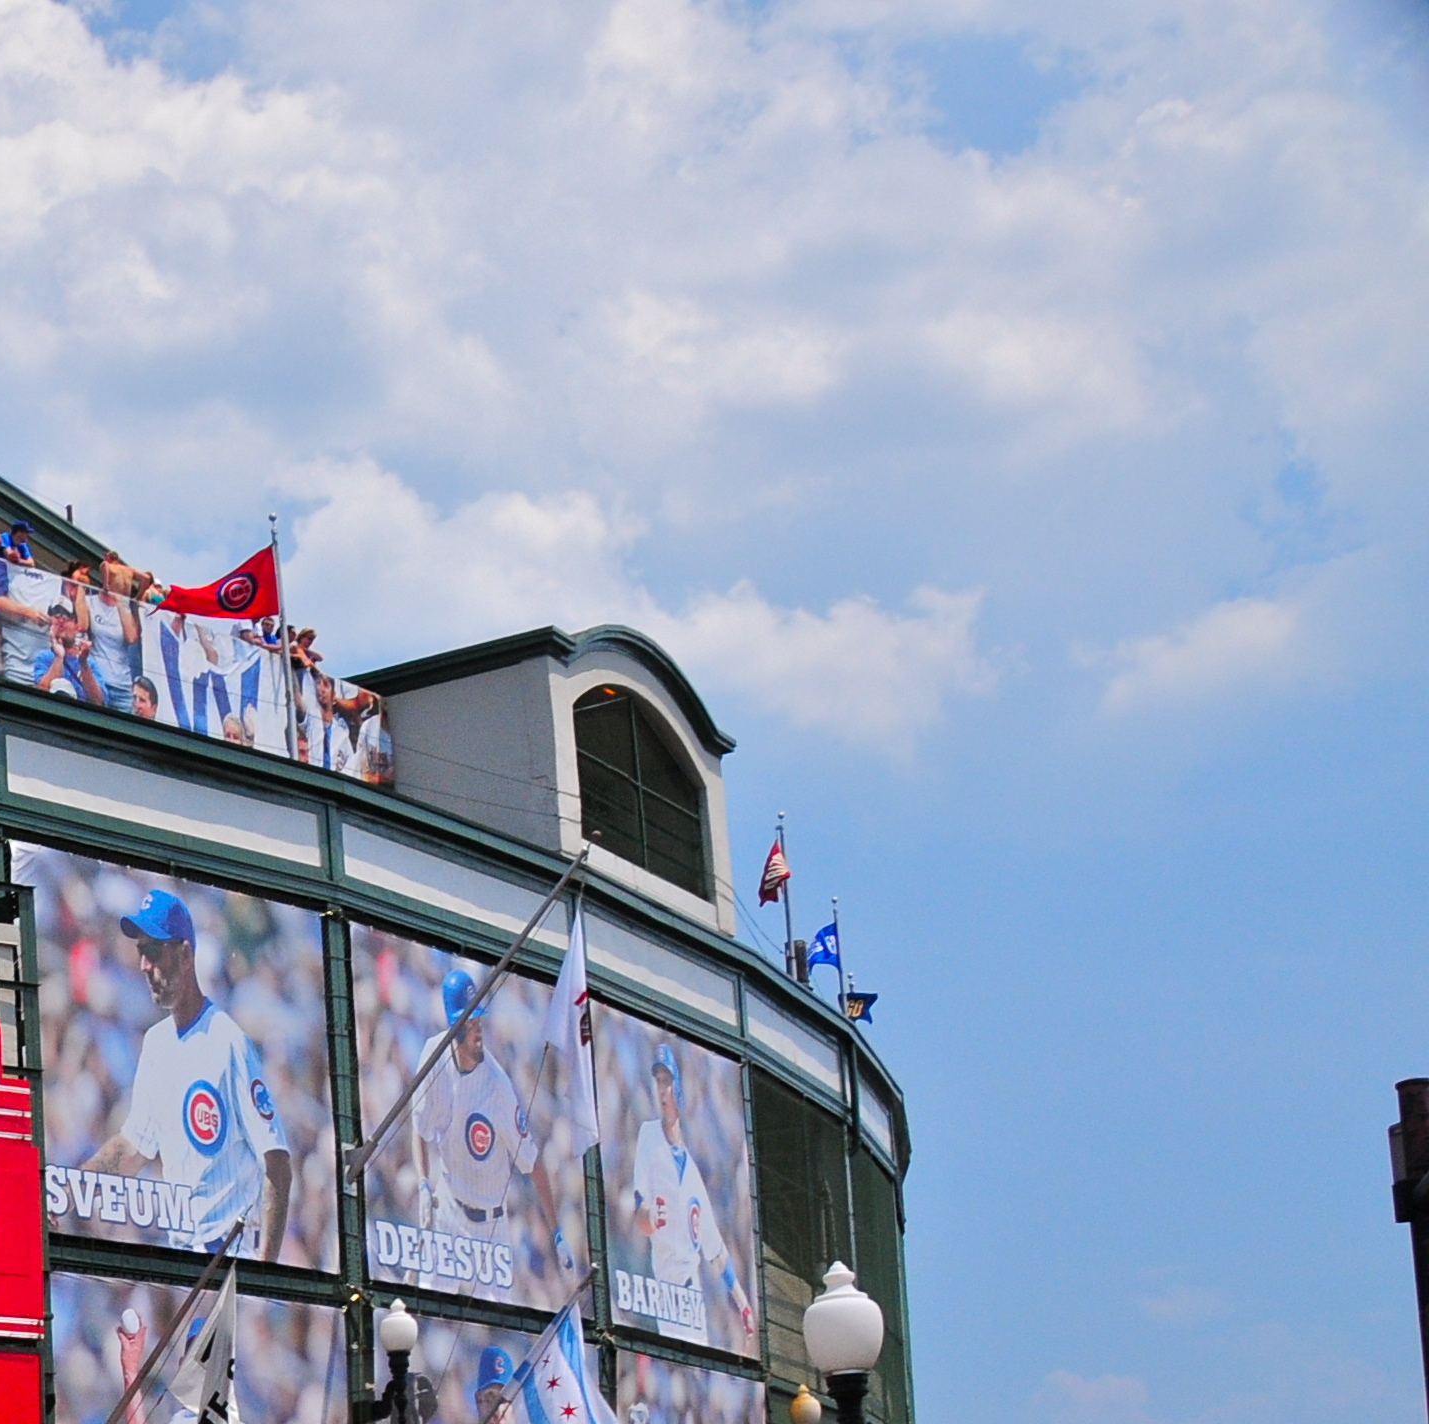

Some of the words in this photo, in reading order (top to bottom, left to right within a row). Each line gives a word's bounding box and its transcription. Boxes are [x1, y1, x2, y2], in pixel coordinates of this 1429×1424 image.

[45, 1165, 197, 1234] SVEUM
[374, 1218, 515, 1289] DEJESUS
[616, 1268, 706, 1330] BARNEY
